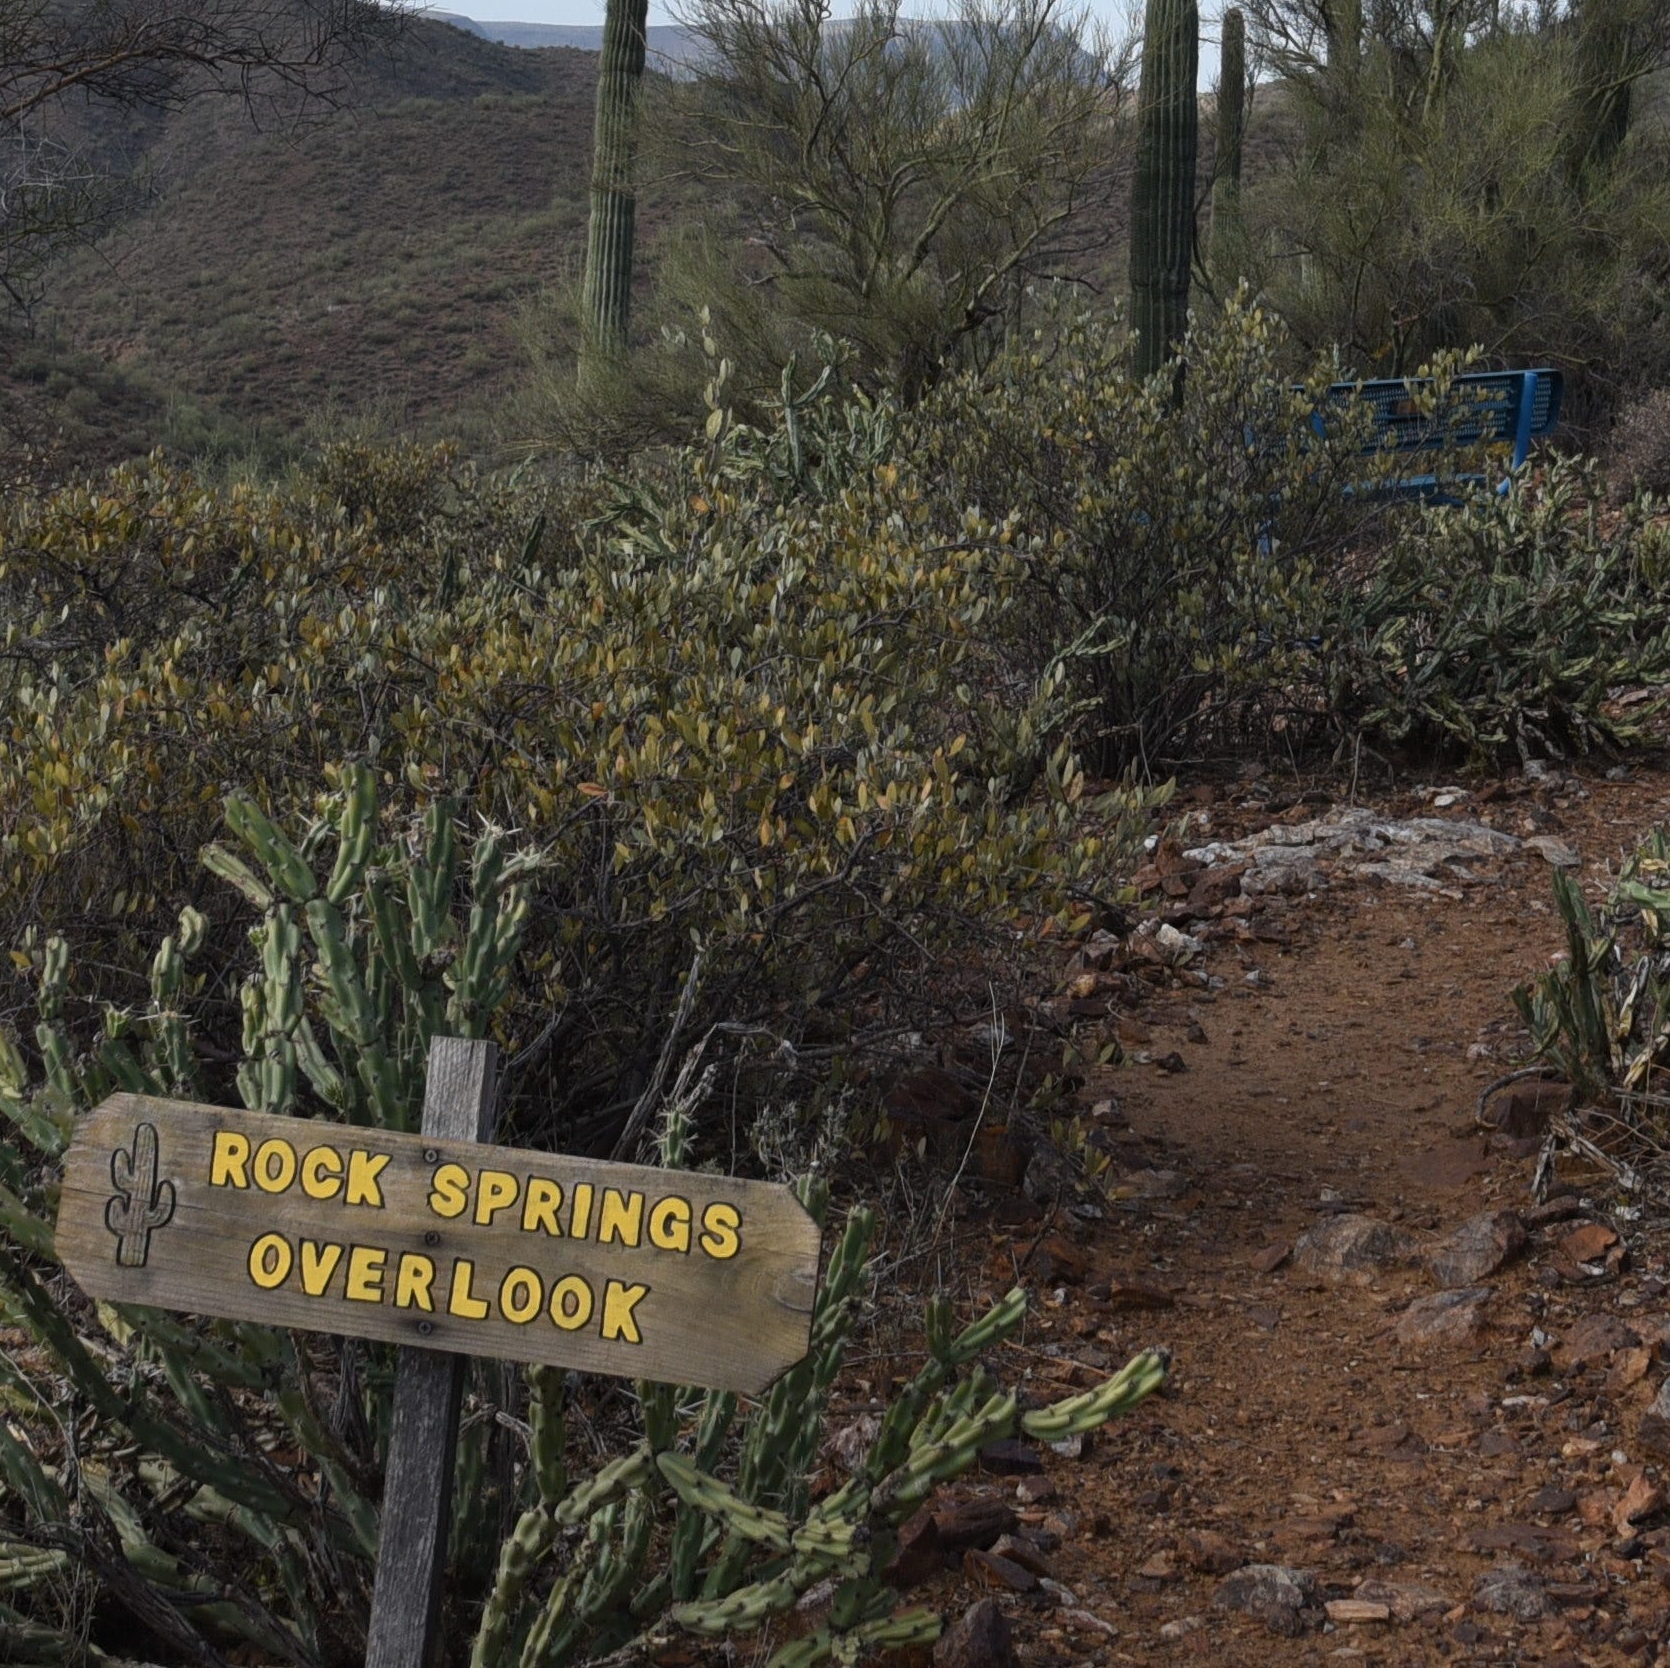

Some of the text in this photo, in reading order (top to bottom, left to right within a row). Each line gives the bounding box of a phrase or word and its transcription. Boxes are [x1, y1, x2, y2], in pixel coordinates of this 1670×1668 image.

[209, 1131, 743, 1260] ROCK SPRINGS
[247, 1231, 650, 1346] OVERLOOK
